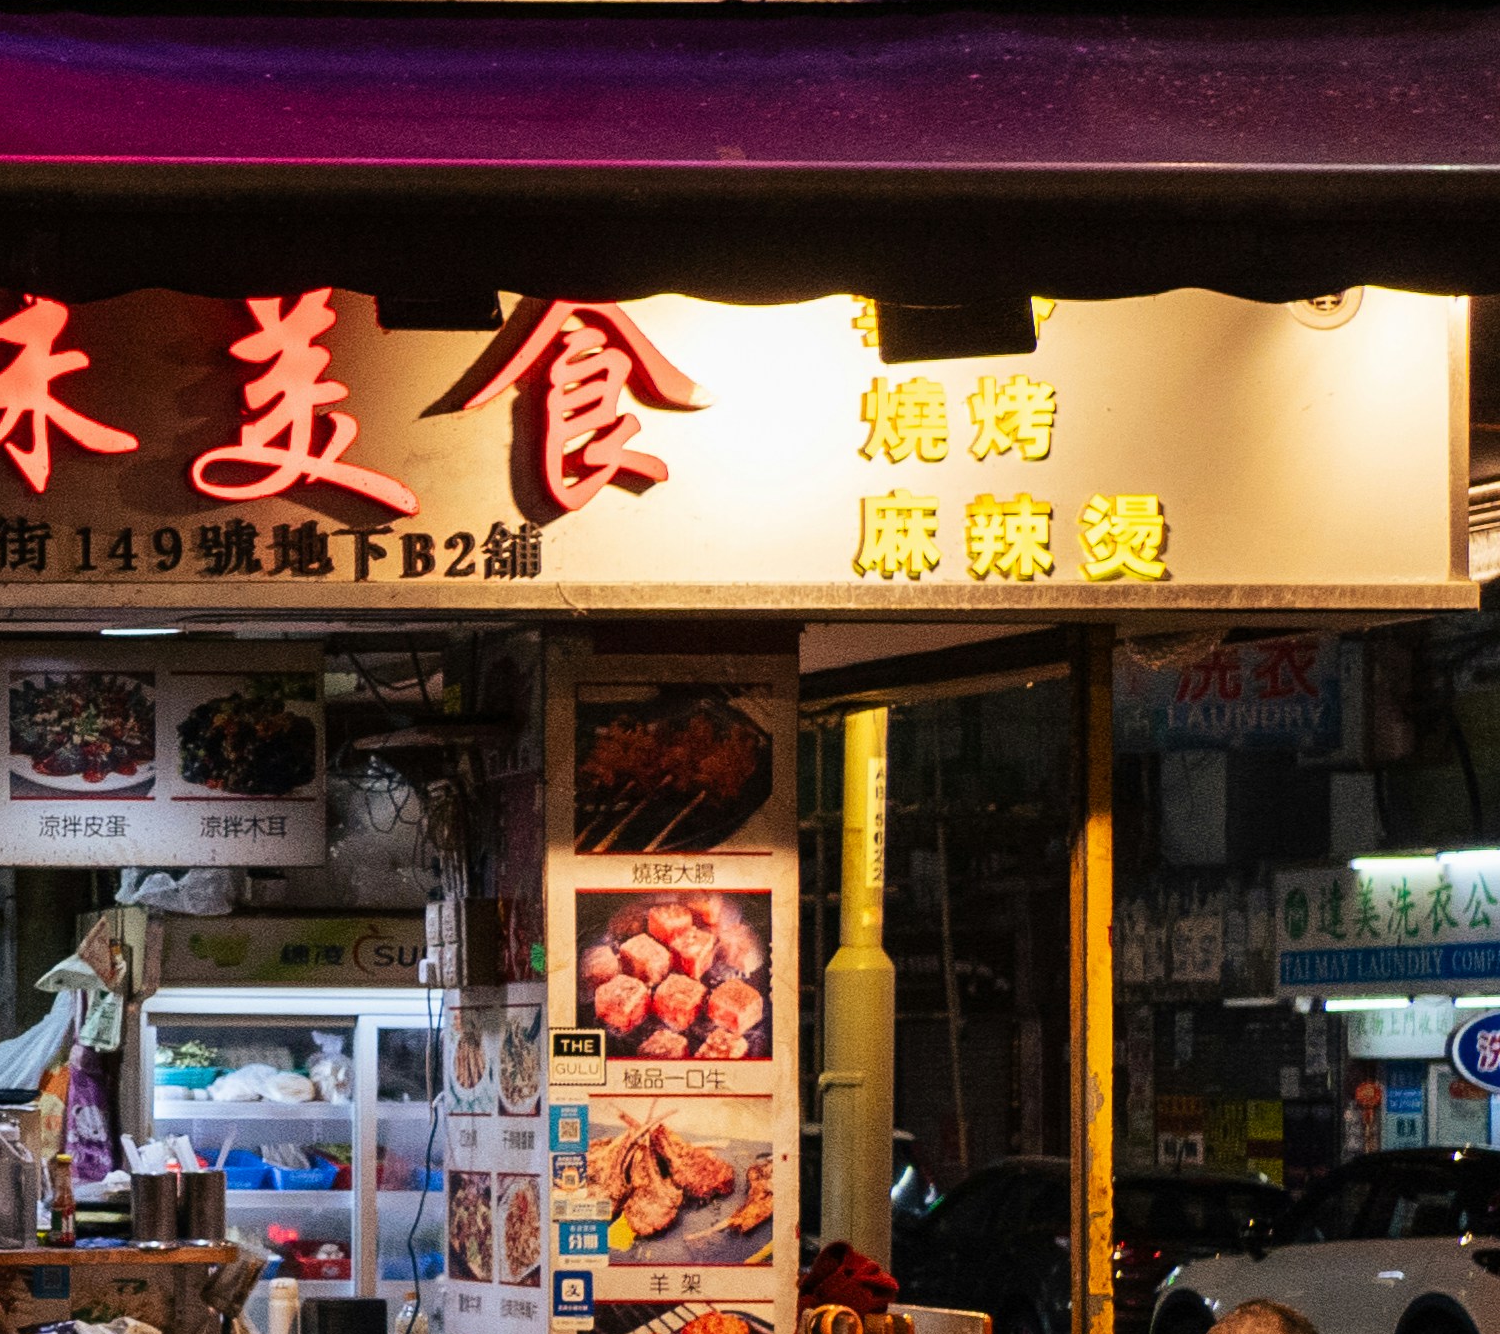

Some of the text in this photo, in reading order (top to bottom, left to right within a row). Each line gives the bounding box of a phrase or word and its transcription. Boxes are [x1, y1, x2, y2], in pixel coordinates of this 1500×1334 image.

[860, 375, 1058, 463] 燒烤
[1167, 704, 1324, 729] LAUNDRY
[39, 814, 130, 839] 涼拌皮蛋
[200, 814, 288, 839] 涼拌木耳
[632, 861, 716, 886] 燒豬大腸
[1357, 948, 1444, 977] LAUNDRY
[560, 1036, 595, 1055] THE
[555, 1060, 600, 1079] GULU
[622, 1068, 727, 1092] 極品一口牛
[650, 1273, 702, 1296] 羊架
